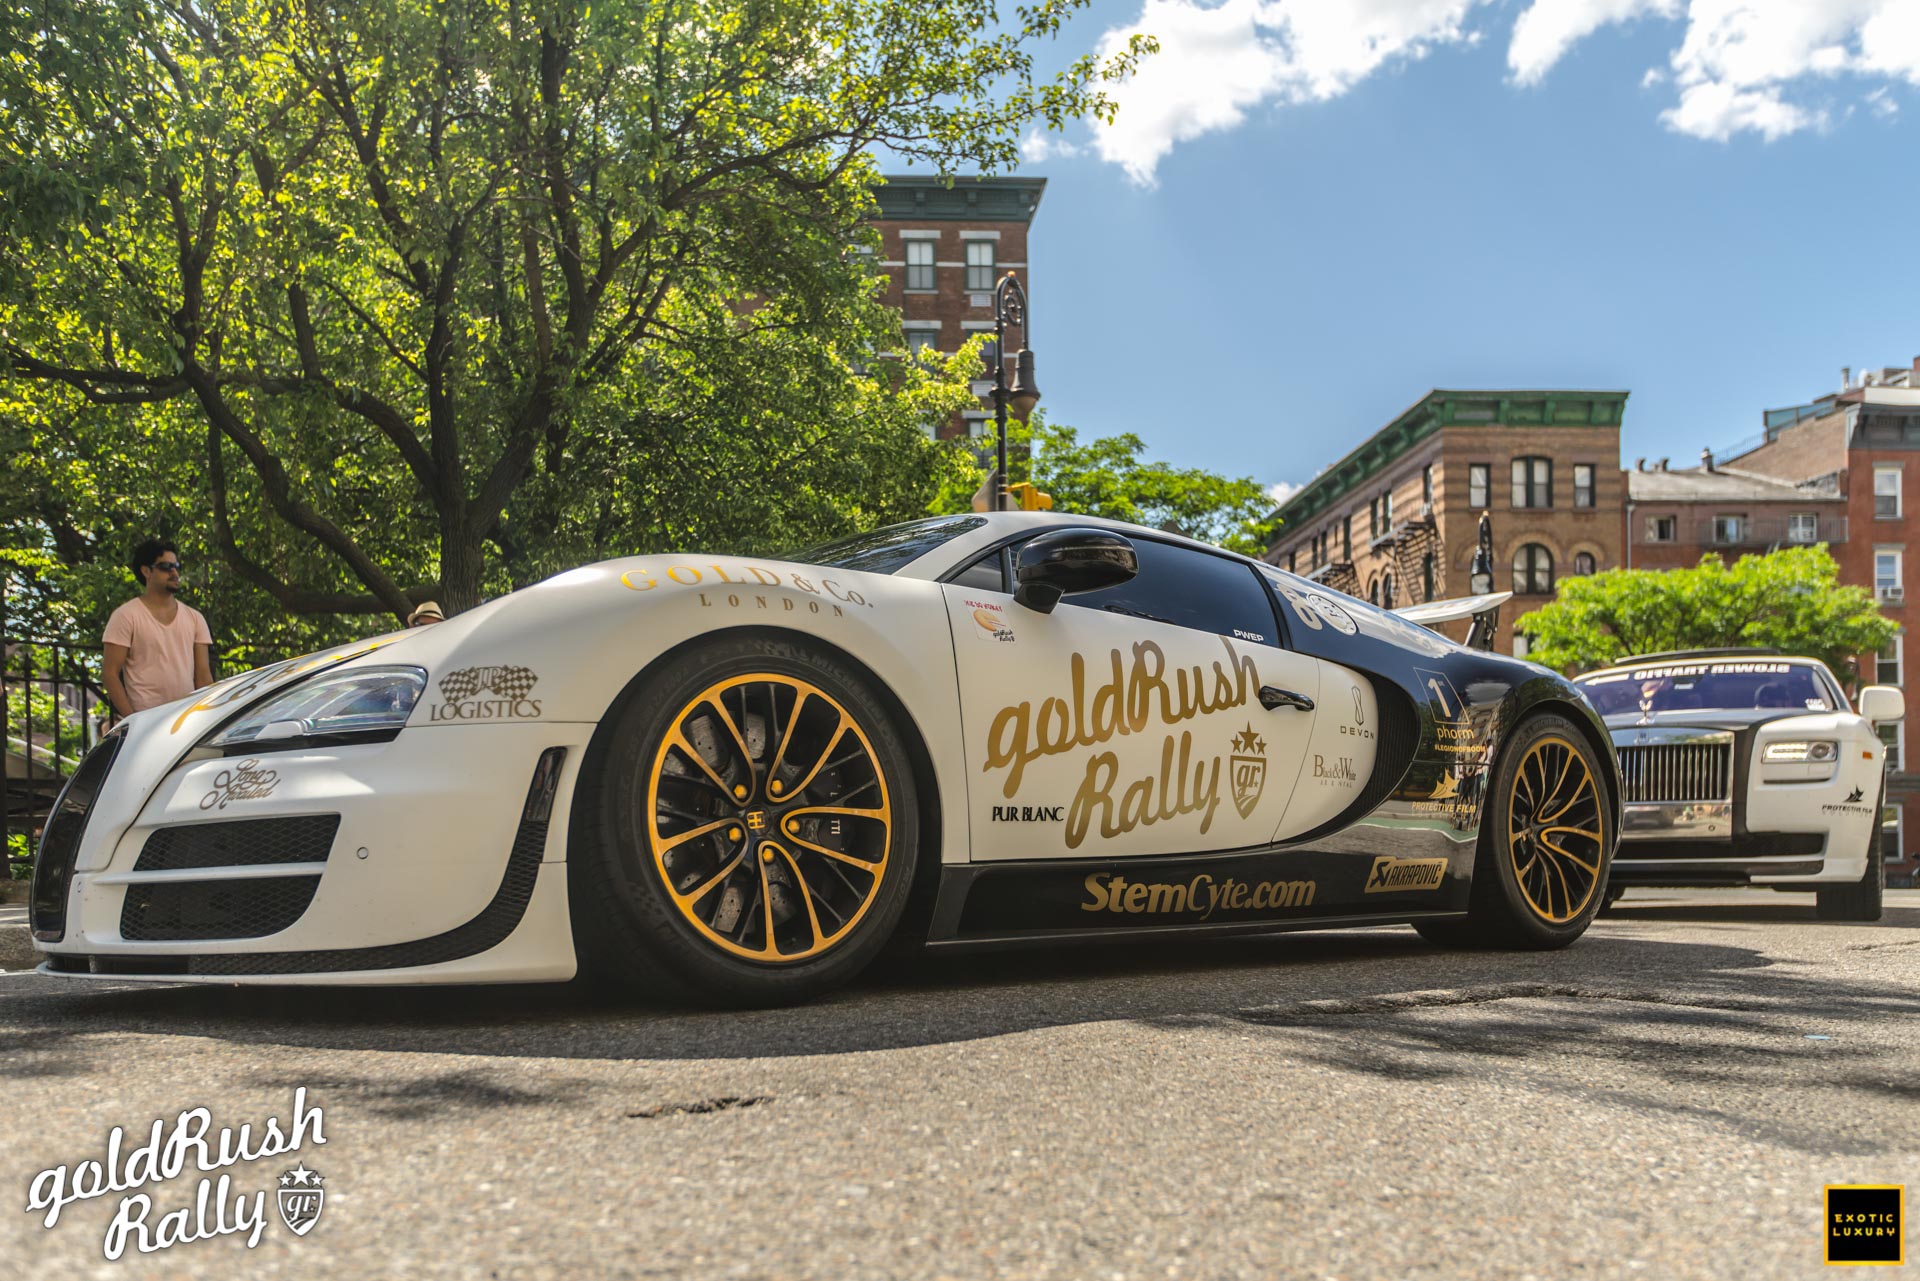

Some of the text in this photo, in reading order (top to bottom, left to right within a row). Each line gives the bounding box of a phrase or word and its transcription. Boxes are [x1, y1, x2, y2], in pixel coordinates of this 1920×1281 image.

[699, 593, 843, 617] LONDON
[430, 699, 542, 721] LOGISTICS
[983, 634, 1262, 798] goldRush
[1340, 725, 1374, 739] DEVON
[1436, 724, 1475, 740] phorm
[1064, 730, 1220, 849] Rally
[992, 806, 1064, 822] PUR BLANC
[1411, 801, 1476, 813] PROTECTIVE FILM
[1081, 872, 1316, 920] StemCyte.com
